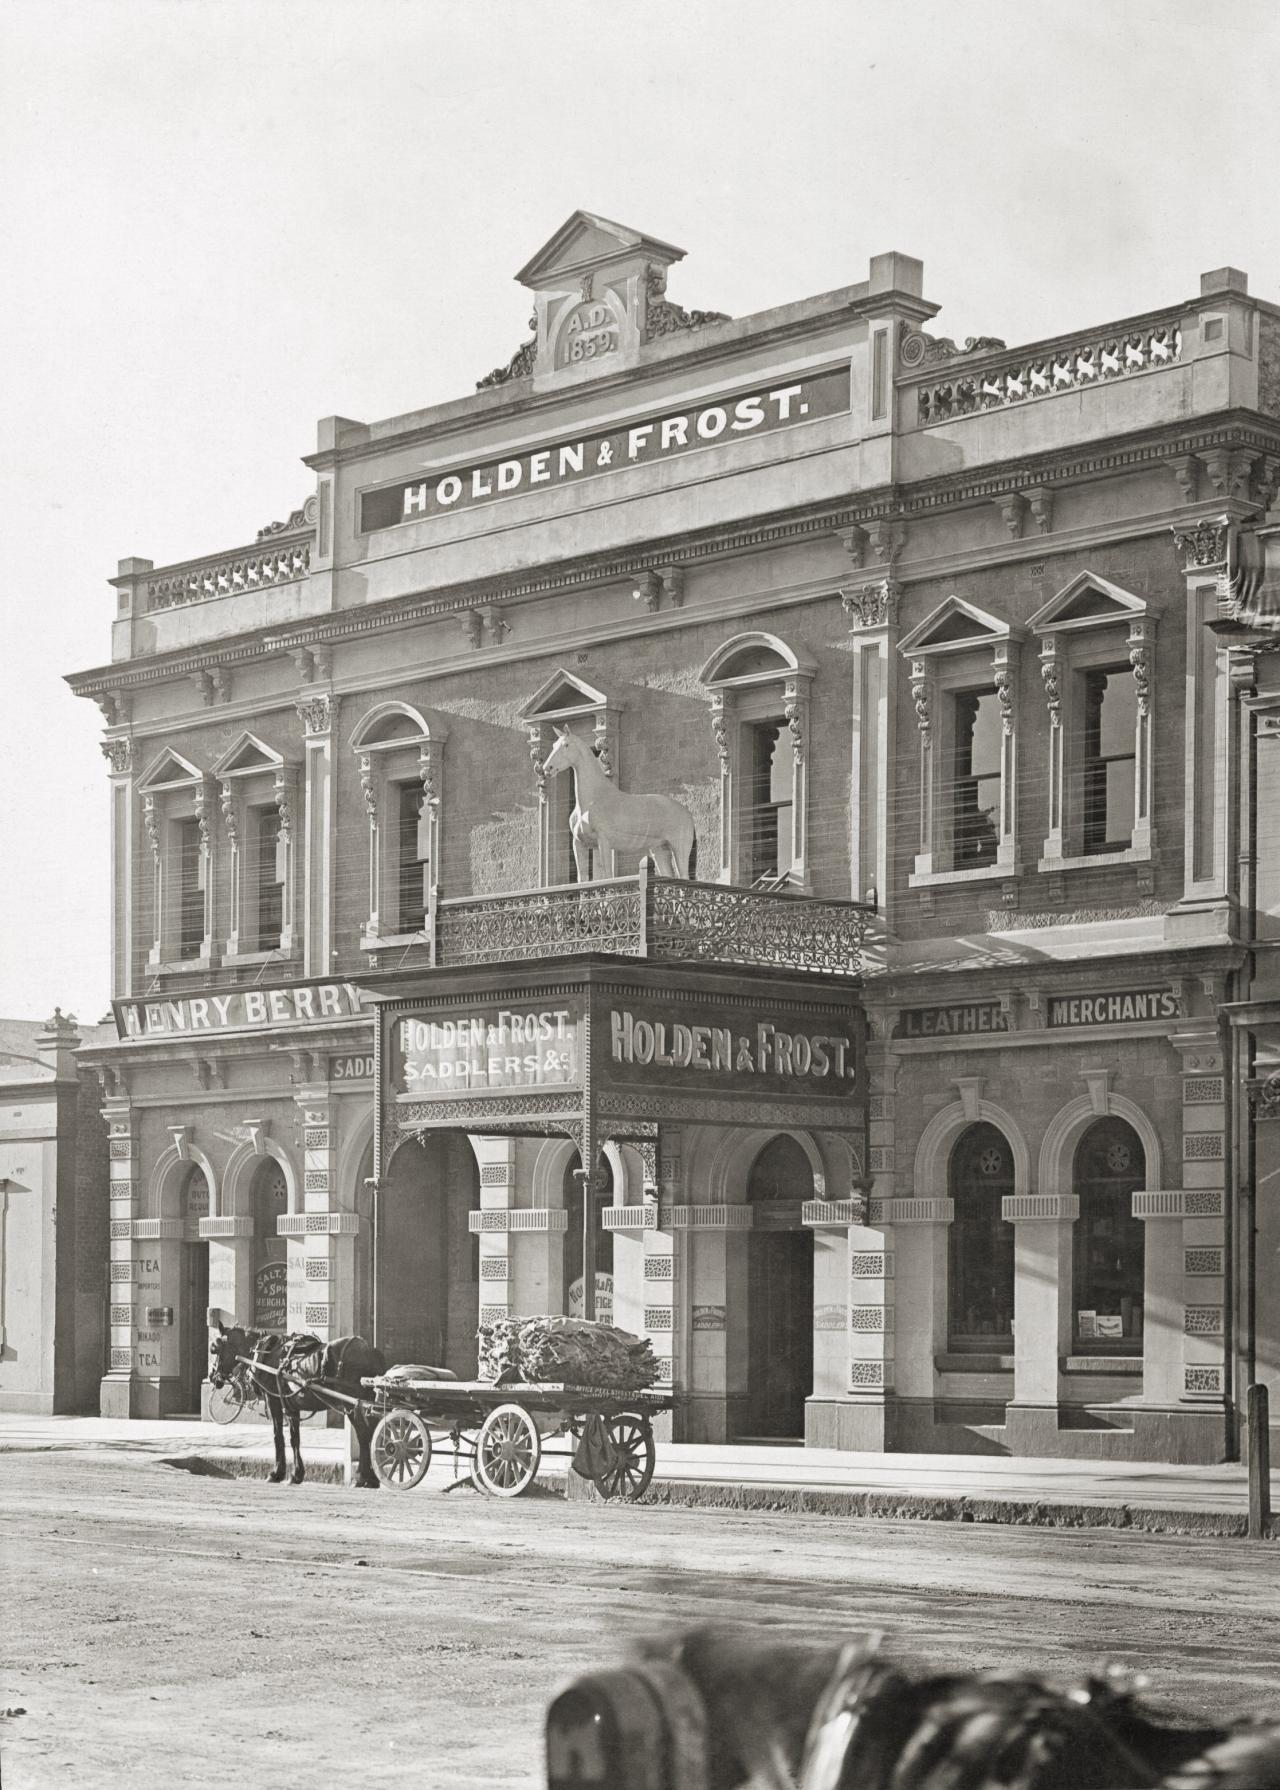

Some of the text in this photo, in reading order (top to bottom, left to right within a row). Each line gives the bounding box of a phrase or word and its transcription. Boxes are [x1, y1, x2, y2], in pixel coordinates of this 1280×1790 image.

[403, 384, 809, 515] HOLDEN & FROST.
[121, 983, 362, 1035] HENRY BERRY
[905, 1006, 1010, 1036] LEATHER
[400, 1011, 574, 1052] HOLDEN & FROST.
[611, 1010, 856, 1079] HOLDEN & FROST.
[403, 1054, 542, 1081] SADDLERS
[139, 1259, 160, 1273] TEA
